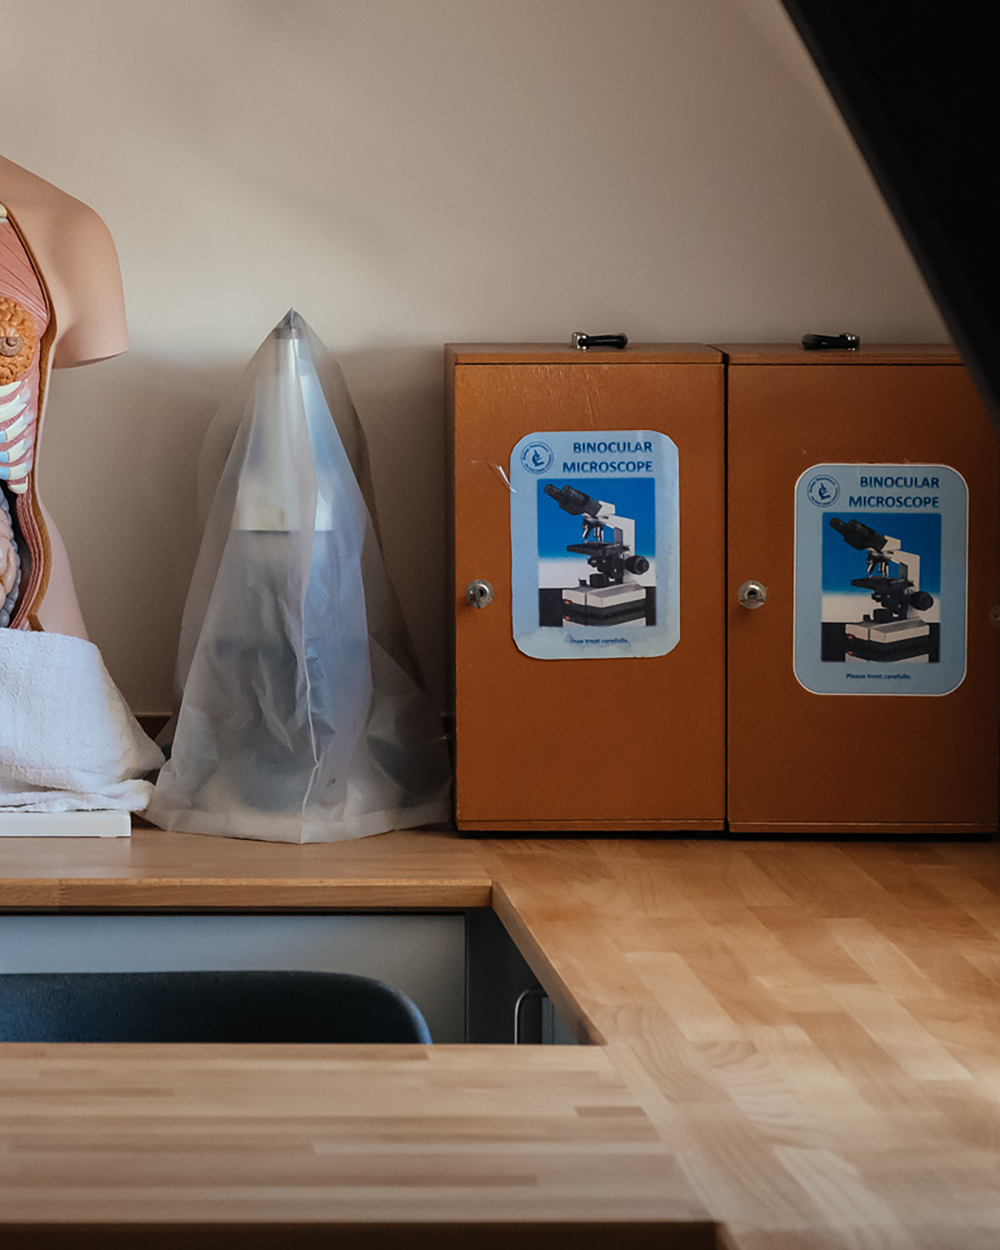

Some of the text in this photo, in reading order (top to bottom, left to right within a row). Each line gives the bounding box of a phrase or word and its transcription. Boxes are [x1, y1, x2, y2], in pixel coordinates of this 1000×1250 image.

[573, 441, 652, 453] BINOCULAR
[563, 461, 653, 473] MICROSCOPE
[860, 476, 940, 488] BINOCULAR
[849, 496, 940, 508] MICROSCOPE
